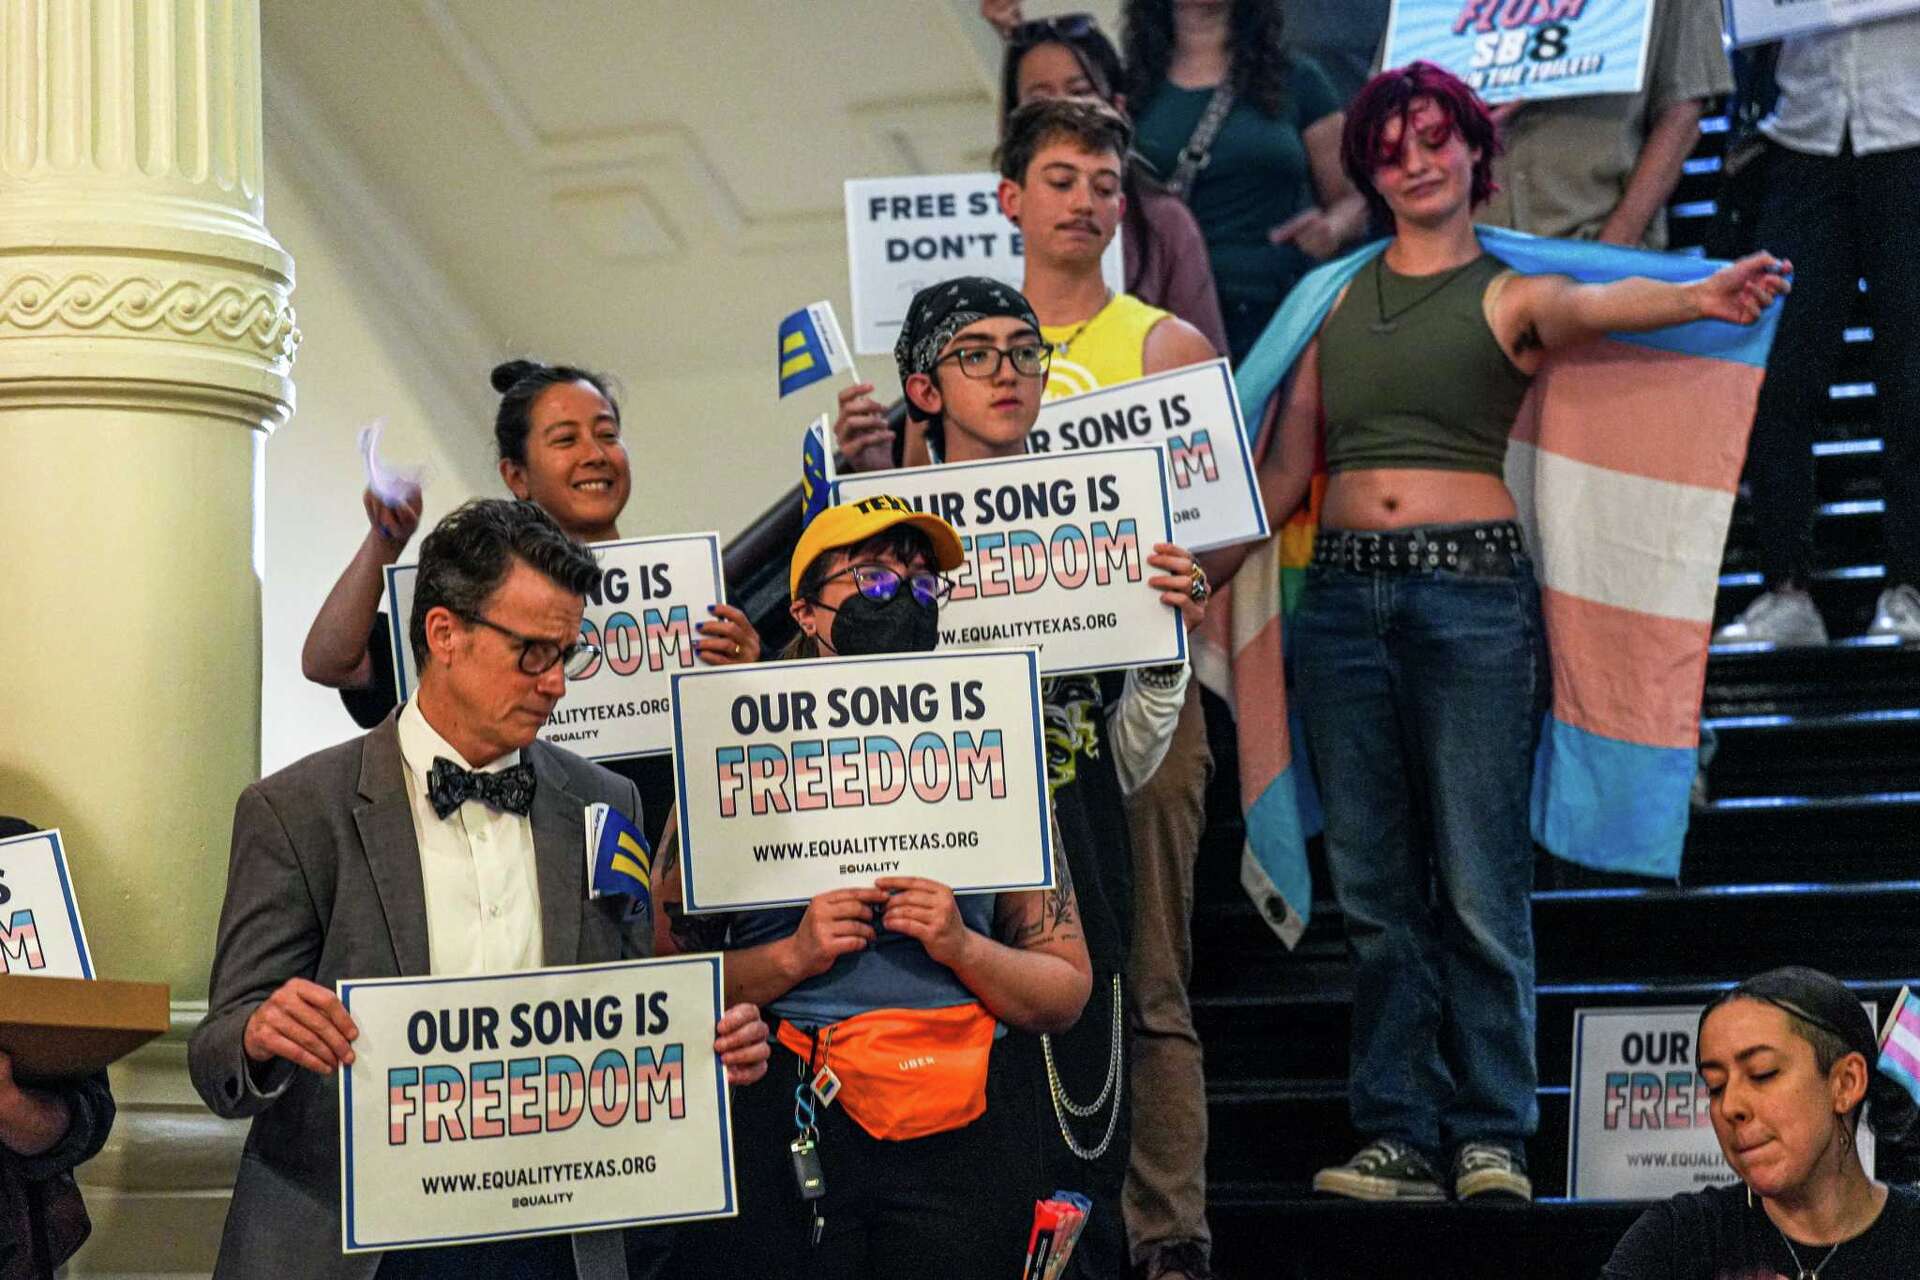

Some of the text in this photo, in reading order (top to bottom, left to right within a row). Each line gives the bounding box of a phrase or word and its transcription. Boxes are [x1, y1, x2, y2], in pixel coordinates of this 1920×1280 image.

[869, 194, 957, 221] FREE
[887, 235, 996, 262] DON'T
[1059, 405, 1151, 451] SONG
[1160, 394, 1191, 430] IS
[974, 480, 1076, 525] SONG
[1086, 475, 1120, 513] IS
[640, 563, 672, 600] IS
[731, 681, 986, 735] OUR SONG IS
[716, 729, 1006, 818] FREEDOM
[753, 831, 979, 862] WWW.EQUALITYTEXAS.ORG
[839, 861, 900, 875] EQUALITY
[407, 991, 669, 1055] OUR SONG IS
[898, 1055, 936, 1071] UBER
[1621, 1030, 1690, 1065] OUR
[388, 1043, 686, 1145] FREEDOM
[422, 1155, 657, 1195] WWW.EQUALITYTEXAS.ORG
[512, 1192, 574, 1208] EQUALITY
